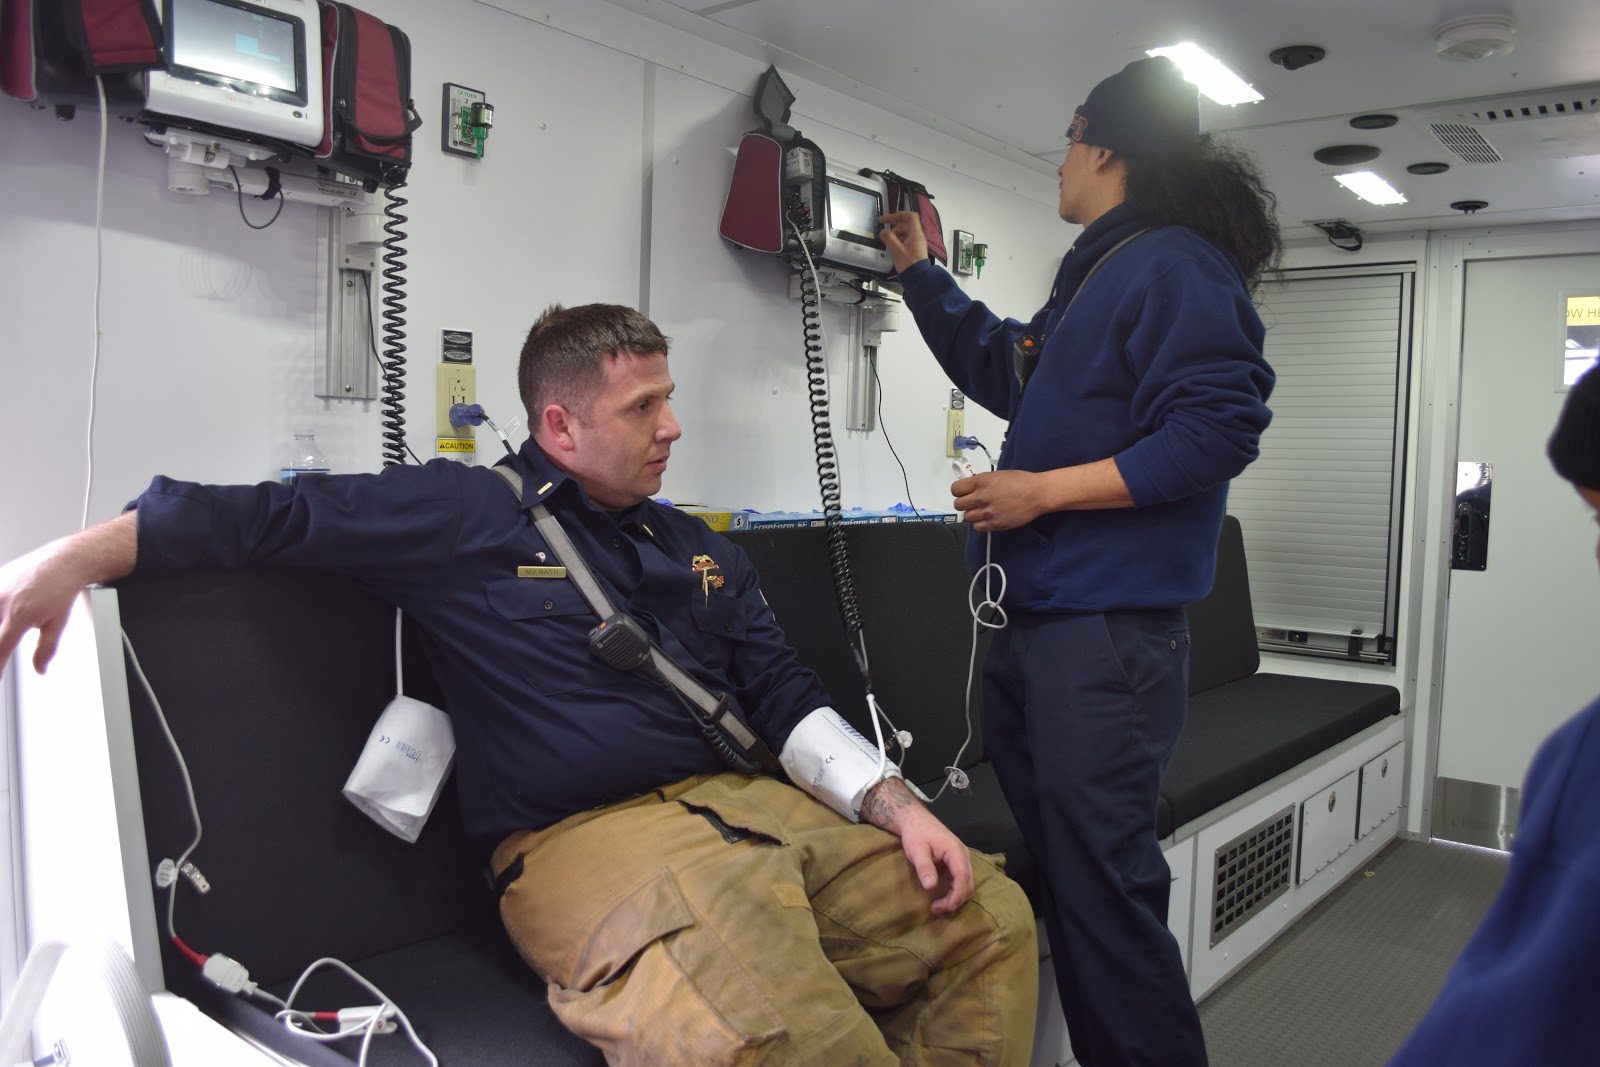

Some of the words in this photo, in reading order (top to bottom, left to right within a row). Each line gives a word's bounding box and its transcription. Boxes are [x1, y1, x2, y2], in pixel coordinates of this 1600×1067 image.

[456, 89, 478, 99] OXYGEN
[445, 442, 474, 450] CAUTION
[735, 517, 741, 526] S
